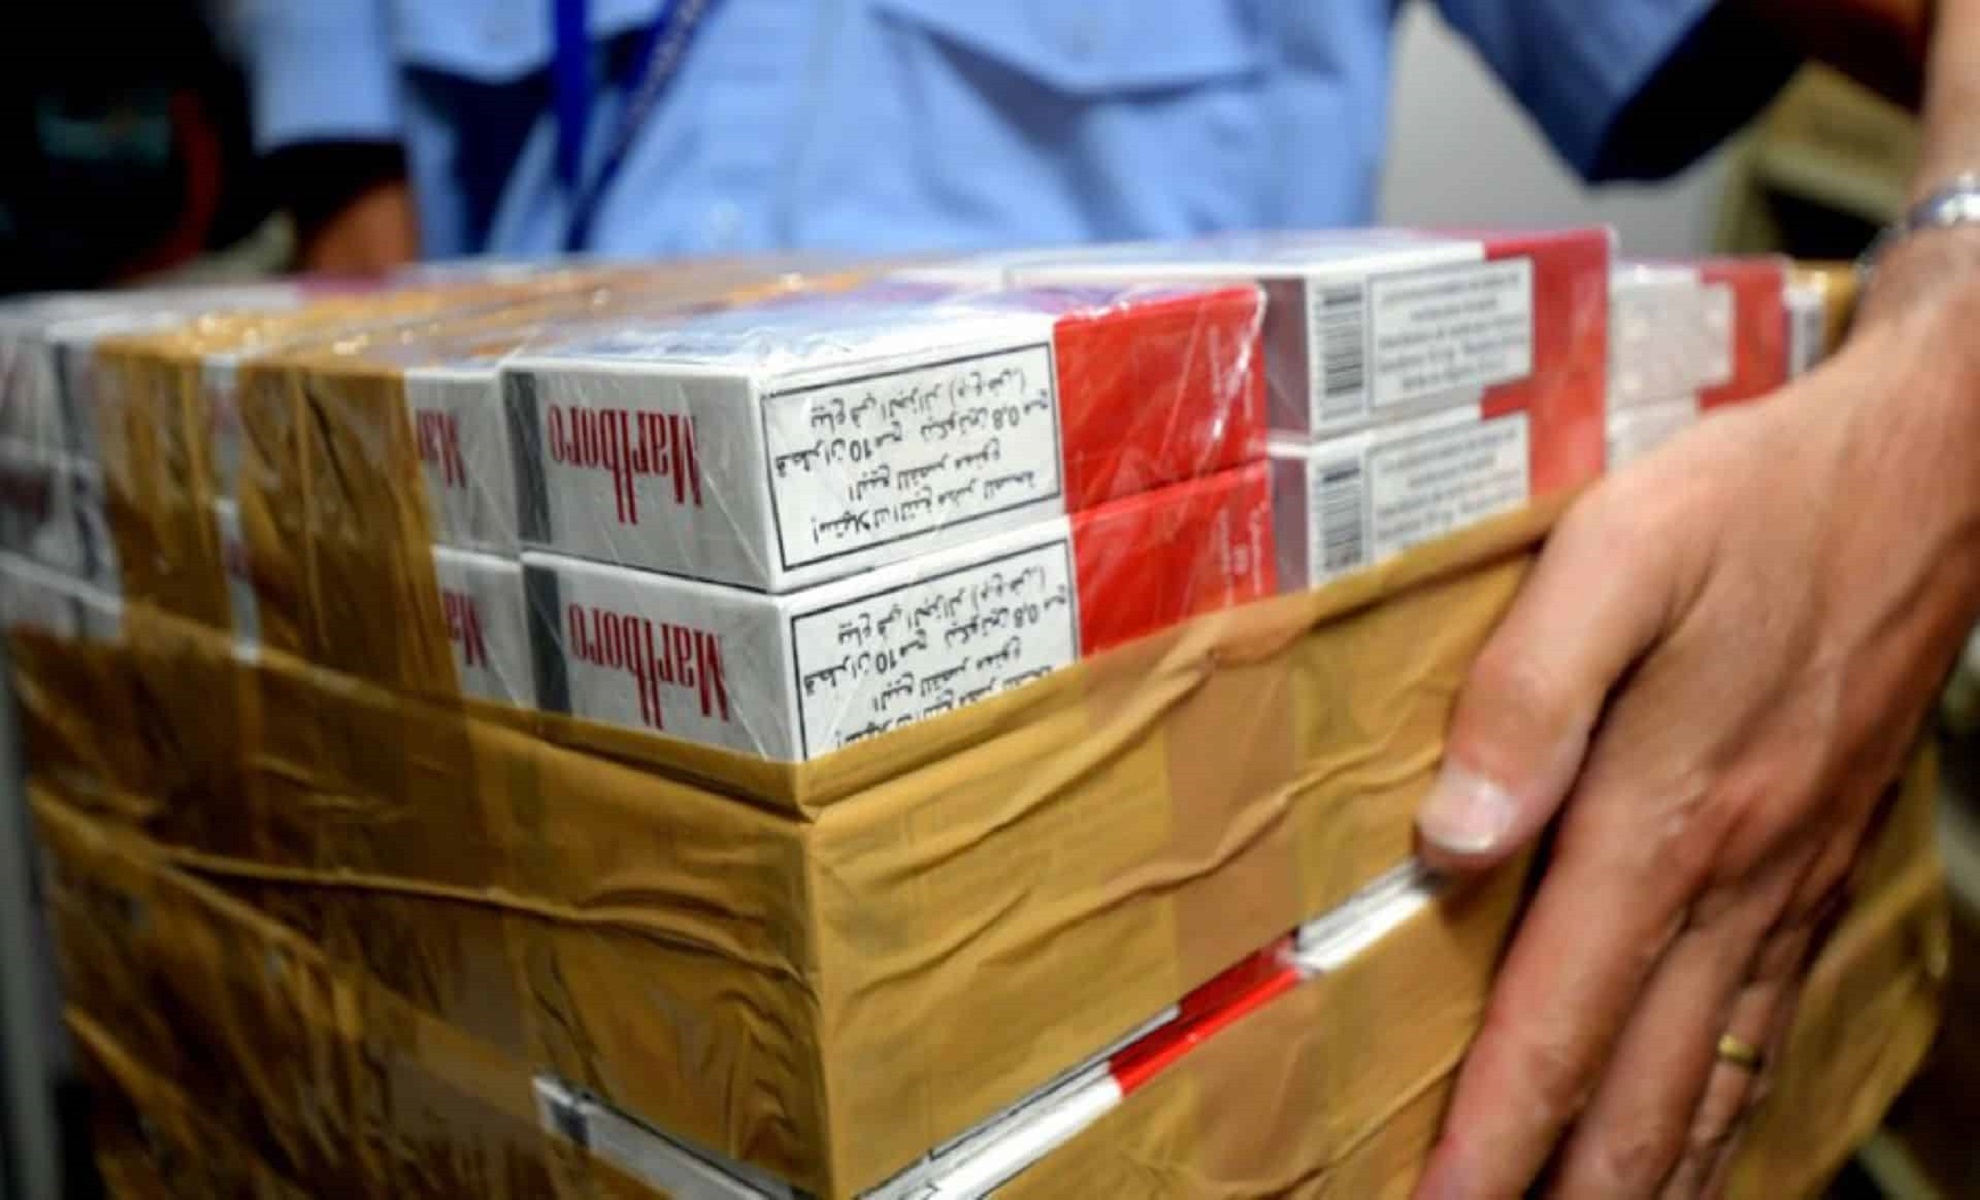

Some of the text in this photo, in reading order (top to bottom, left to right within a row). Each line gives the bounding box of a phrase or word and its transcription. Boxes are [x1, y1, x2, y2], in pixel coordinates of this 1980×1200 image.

[850, 392, 877, 428] في
[549, 404, 703, 525] Marlboro
[850, 439, 872, 462] 10
[849, 438, 1000, 502] البيع للقصر ممنوع
[937, 478, 977, 507] مضر
[876, 602, 903, 640] في
[569, 602, 730, 730] Marlboro
[876, 649, 897, 674] 10
[873, 671, 914, 712] البيع
[920, 656, 970, 697] للقصر
